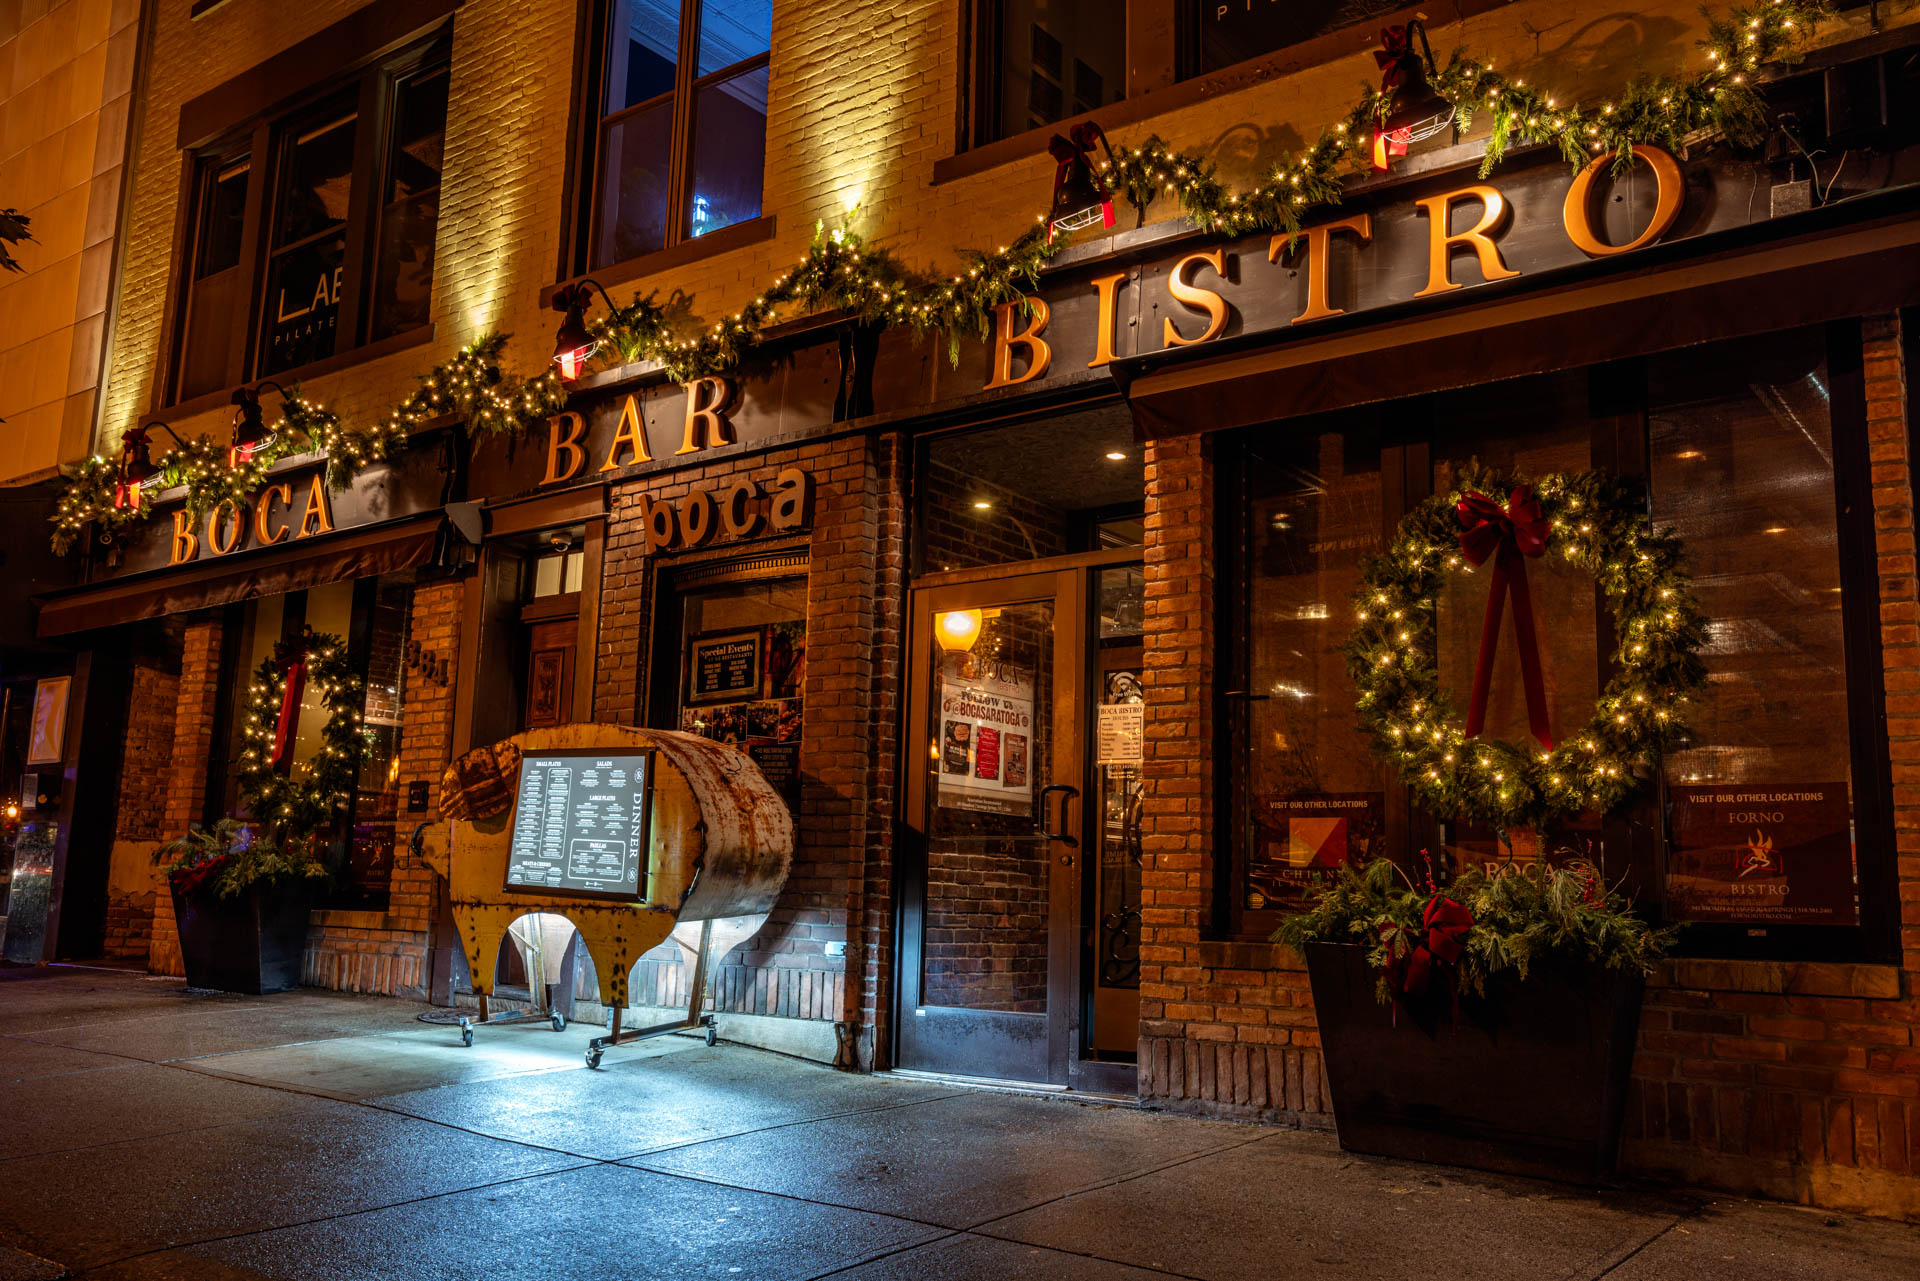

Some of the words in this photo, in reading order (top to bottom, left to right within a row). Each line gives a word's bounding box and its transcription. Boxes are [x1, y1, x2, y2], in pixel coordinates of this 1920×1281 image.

[1217, 0, 1279, 22] PI
[983, 145, 1686, 391] BISTRO
[539, 376, 734, 487] BAR
[168, 474, 334, 566] BOCA
[640, 467, 811, 551] boca
[699, 645, 727, 660] Special
[727, 642, 754, 654] Events
[404, 640, 448, 687] 384
[978, 658, 1019, 685] BOCA
[960, 691, 1000, 707] FOLLOW
[1101, 707, 1117, 715] BOCA
[1119, 706, 1143, 714] BISTRO
[953, 701, 1021, 727] @BOCASARATOGA
[1270, 801, 1289, 809] VISIT
[1289, 801, 1303, 809] OUR
[1304, 801, 1327, 809] OTHER
[1328, 800, 1369, 808] LOCATIONS
[1689, 794, 1715, 803] VISIT
[1716, 794, 1735, 803] OUR
[1736, 793, 1768, 803] OTHER
[1769, 792, 1824, 802] LOCATIONS
[629, 792, 642, 859] DINNER
[1728, 811, 1785, 824] FORNO
[1731, 884, 1791, 896] BISTRO
